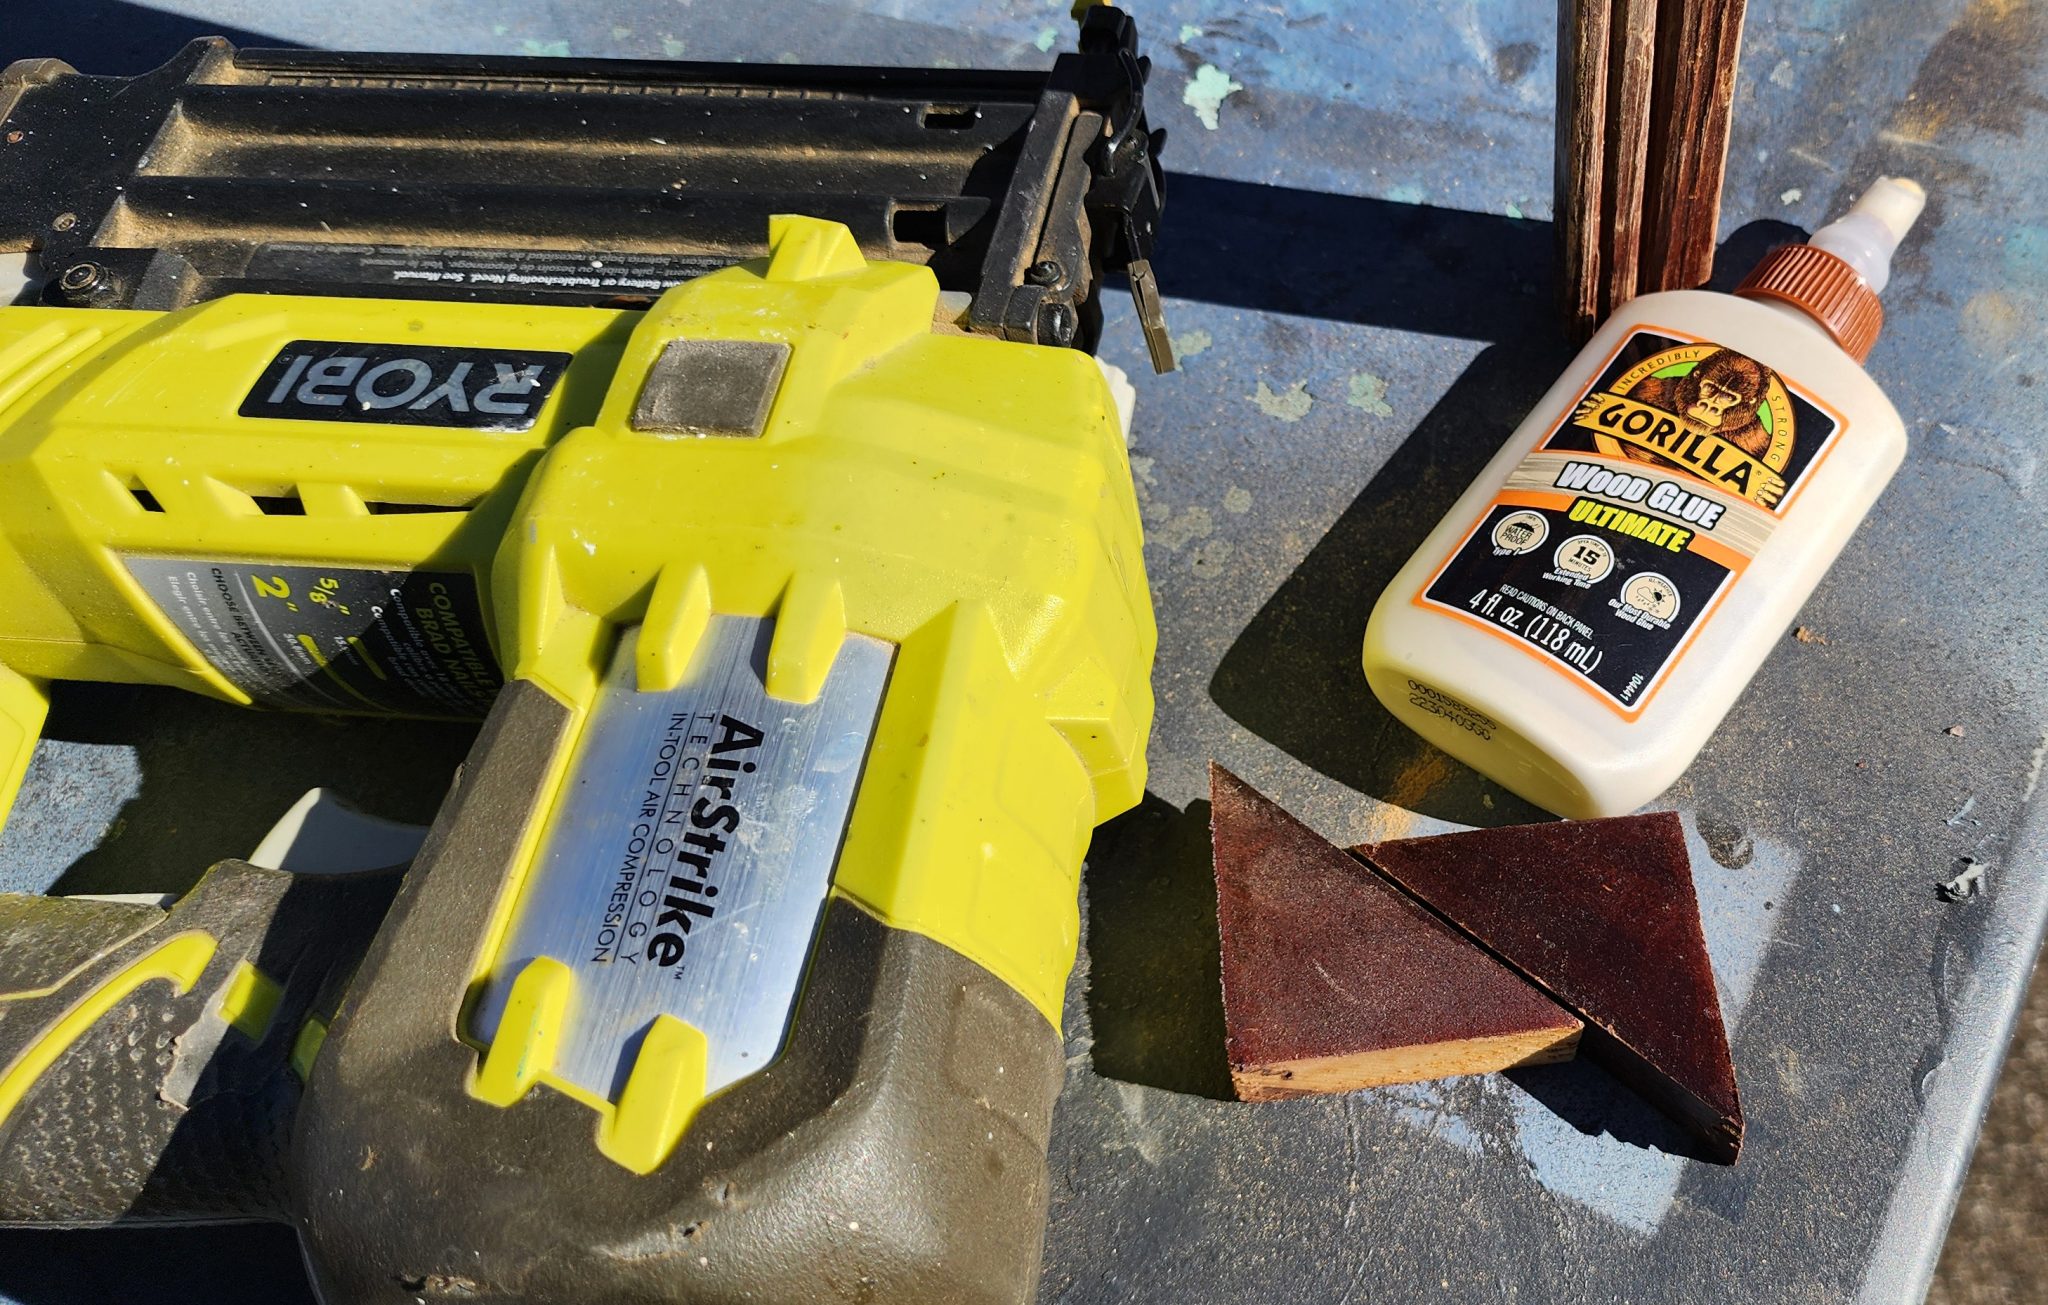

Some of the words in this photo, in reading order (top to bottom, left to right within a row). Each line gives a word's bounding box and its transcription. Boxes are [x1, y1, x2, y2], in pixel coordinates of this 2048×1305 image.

[393, 270, 441, 281] Manual.
[440, 272, 466, 283] See
[469, 272, 506, 284] Need.
[506, 273, 601, 287] Troubleshooting
[601, 276, 617, 286] or
[617, 277, 661, 290] Battery
[267, 355, 546, 415] RYOBI
[1617, 349, 1701, 391] INCREDIBLY
[1598, 403, 1753, 496] GORILLA
[1771, 395, 1788, 463] STRONG
[1557, 462, 1650, 502] WOOD
[1648, 483, 1724, 529] GLUE
[1501, 532, 1529, 546] PROOF
[1568, 499, 1690, 553] ULTIMATE
[1492, 546, 1513, 556] Type
[1568, 558, 1592, 572] MINUTES
[1573, 545, 1601, 566] 15
[1542, 571, 1573, 586] Working
[1573, 579, 1592, 589] Time
[1554, 567, 1590, 581] Extended
[168, 576, 188, 604] Elegir
[183, 605, 202, 629] entre
[187, 571, 208, 606] Choisir
[203, 606, 222, 630] entre
[211, 567, 241, 613] CHOOSE
[232, 615, 268, 656] BETWEEN
[390, 588, 424, 648] Compatible
[1500, 583, 1517, 598] READ
[1516, 591, 1548, 612] CAUTIONS
[1545, 605, 1557, 616] ON
[1555, 609, 1578, 629] BACK
[1608, 598, 1624, 609] Our
[1623, 603, 1643, 617] Most
[1640, 611, 1671, 630] Durable
[1614, 608, 1638, 624] Wood
[1635, 616, 1655, 631] Glue
[370, 605, 408, 660] Compatible
[415, 607, 453, 654] BRAD
[428, 582, 497, 689] COMPATIBLE
[1468, 588, 1488, 609] 4
[1481, 594, 1503, 618] fl.
[1499, 606, 1525, 630] oz.
[1524, 613, 1571, 651] (118
[1563, 641, 1603, 675] mL)
[1619, 672, 1644, 702] 104441
[649, 712, 688, 786] IN-TOOL
[639, 789, 661, 818] AIR
[620, 713, 715, 965] TECHNOLOGY
[590, 823, 651, 964] COMPRESSION
